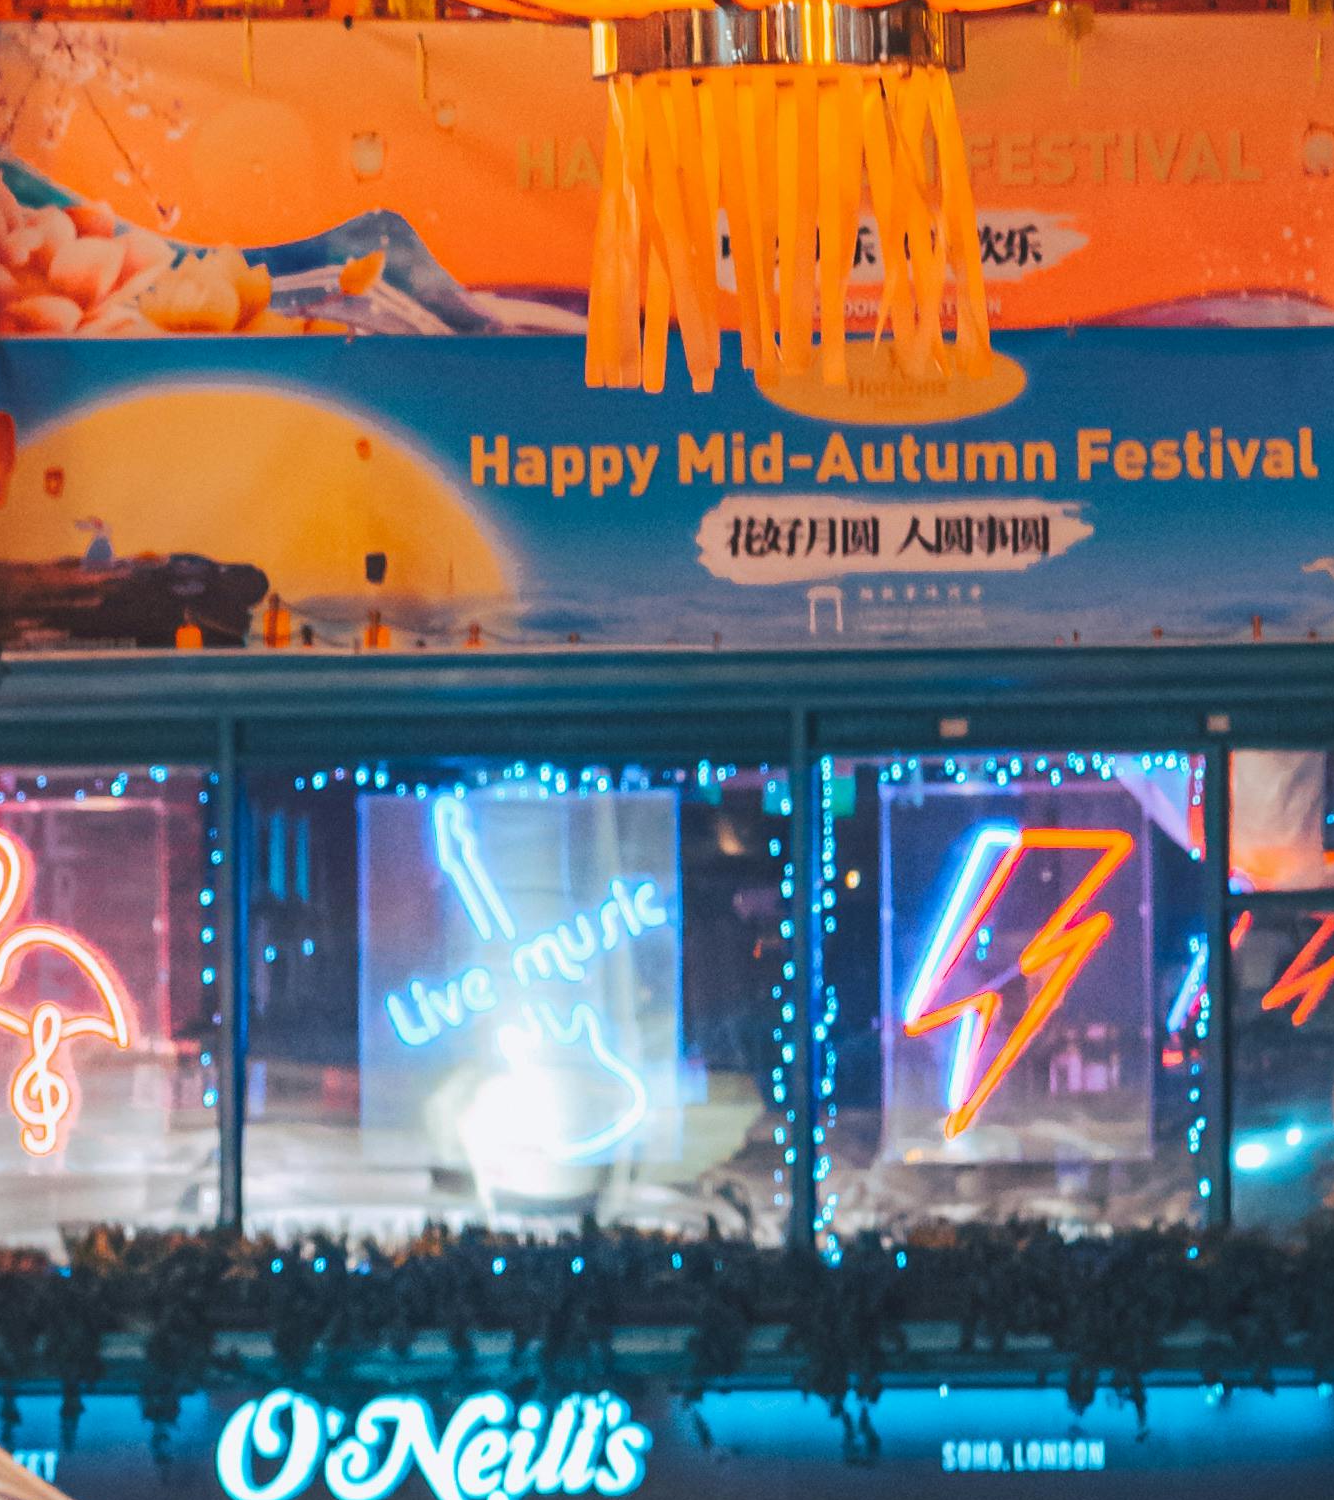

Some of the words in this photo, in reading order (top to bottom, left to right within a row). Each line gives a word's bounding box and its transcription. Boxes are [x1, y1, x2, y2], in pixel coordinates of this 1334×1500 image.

[471, 434, 660, 498] Happy
[678, 430, 1056, 486] Mid-Autumn
[1077, 427, 1318, 481] Festival
[725, 514, 880, 559] 花好月圆
[384, 966, 497, 1047] Live
[512, 878, 668, 987] music
[1012, 1439, 1106, 1472] LONDON
